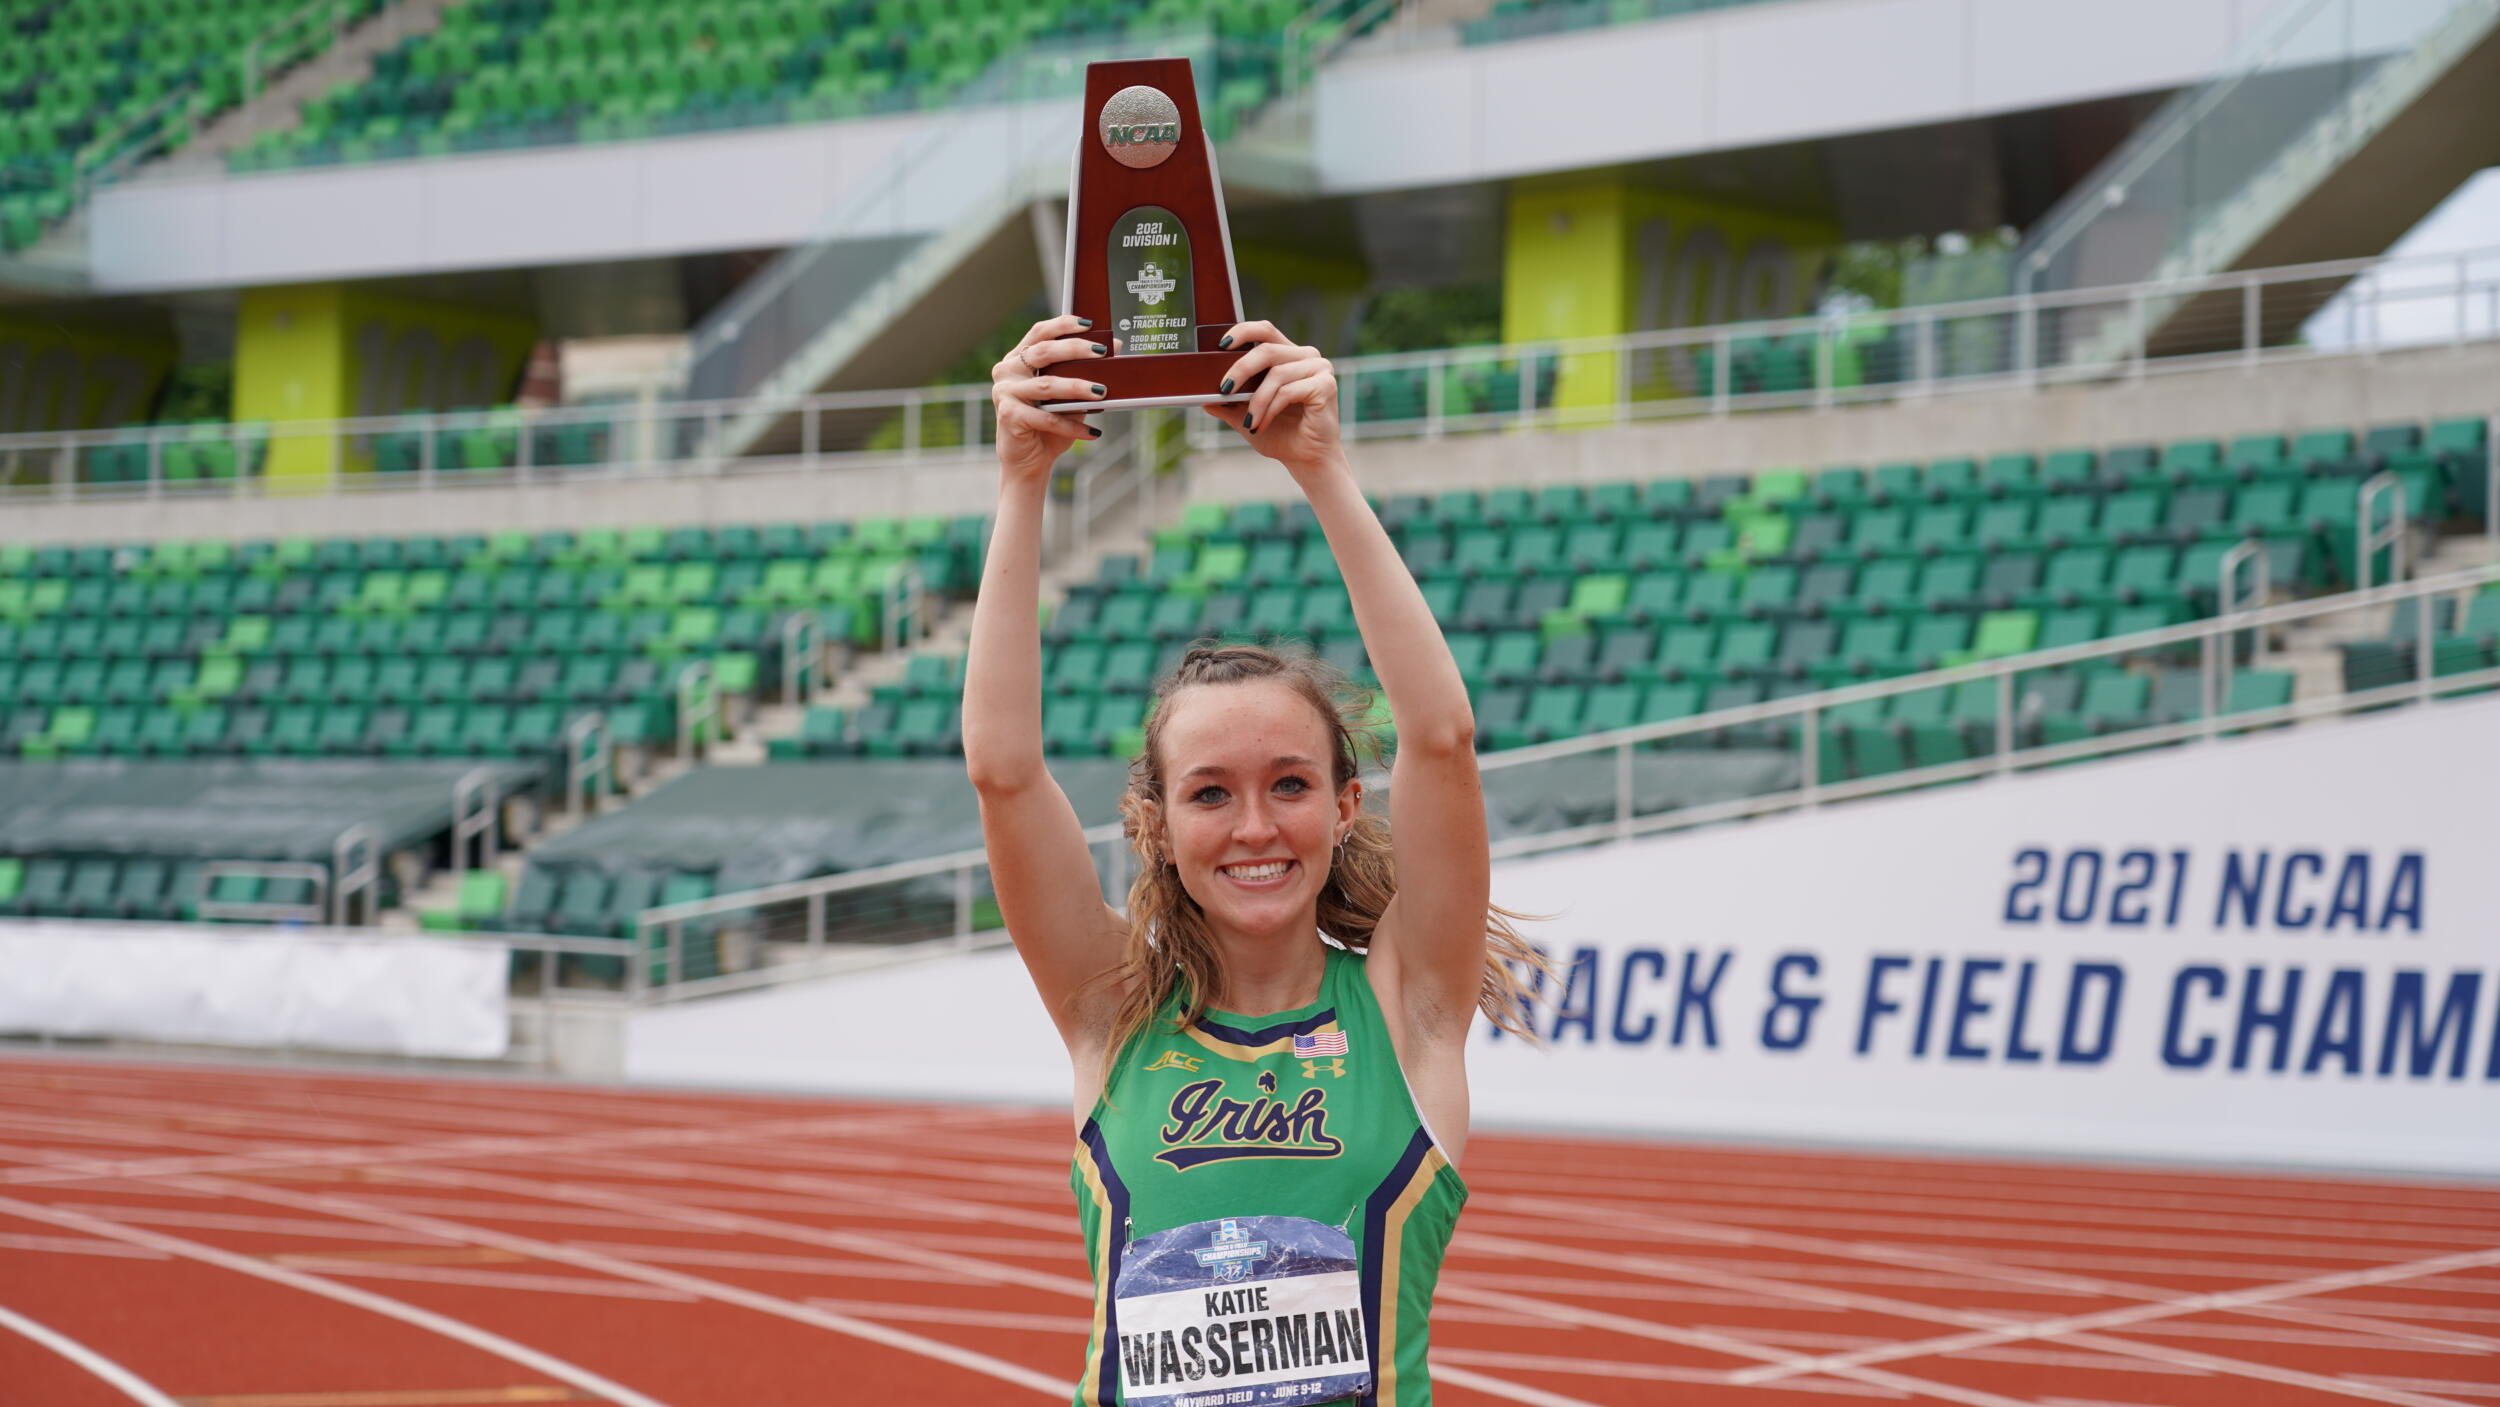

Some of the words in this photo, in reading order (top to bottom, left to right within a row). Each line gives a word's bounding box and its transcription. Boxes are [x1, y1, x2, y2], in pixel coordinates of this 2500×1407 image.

[1106, 122, 1178, 147] NCAA
[1136, 222, 1163, 235] 2021
[1122, 234, 1171, 248] DIVISION
[1173, 233, 1178, 246] I
[1132, 319, 1158, 329] TRACK
[1158, 318, 1165, 328] &
[1165, 317, 1187, 328] FIELD
[1129, 342, 1157, 351] SECOND
[1158, 341, 1180, 350] PLACE
[1130, 334, 1150, 343] 5000
[1150, 333, 1178, 342] METERS
[2003, 849, 2190, 927] 2021
[2213, 851, 2426, 932] NCAA
[1488, 945, 1733, 1048] RACK
[1760, 953, 1823, 1051] &
[1855, 956, 2126, 1064] FIELD
[2160, 966, 2500, 1081] CHAM
[1142, 1050, 1205, 1072] ACC
[1155, 1074, 1344, 1168] Irish
[1202, 1247, 1262, 1261] CHAMPIONSHIPS
[1204, 1286, 1270, 1317] KATIE
[1120, 1308, 1364, 1387] WASSERMAN
[1175, 1393, 1225, 1407] HAYWARD
[1226, 1391, 1253, 1405] FIELD
[1272, 1384, 1299, 1398] JUNE
[1300, 1382, 1322, 1395] 9-12
